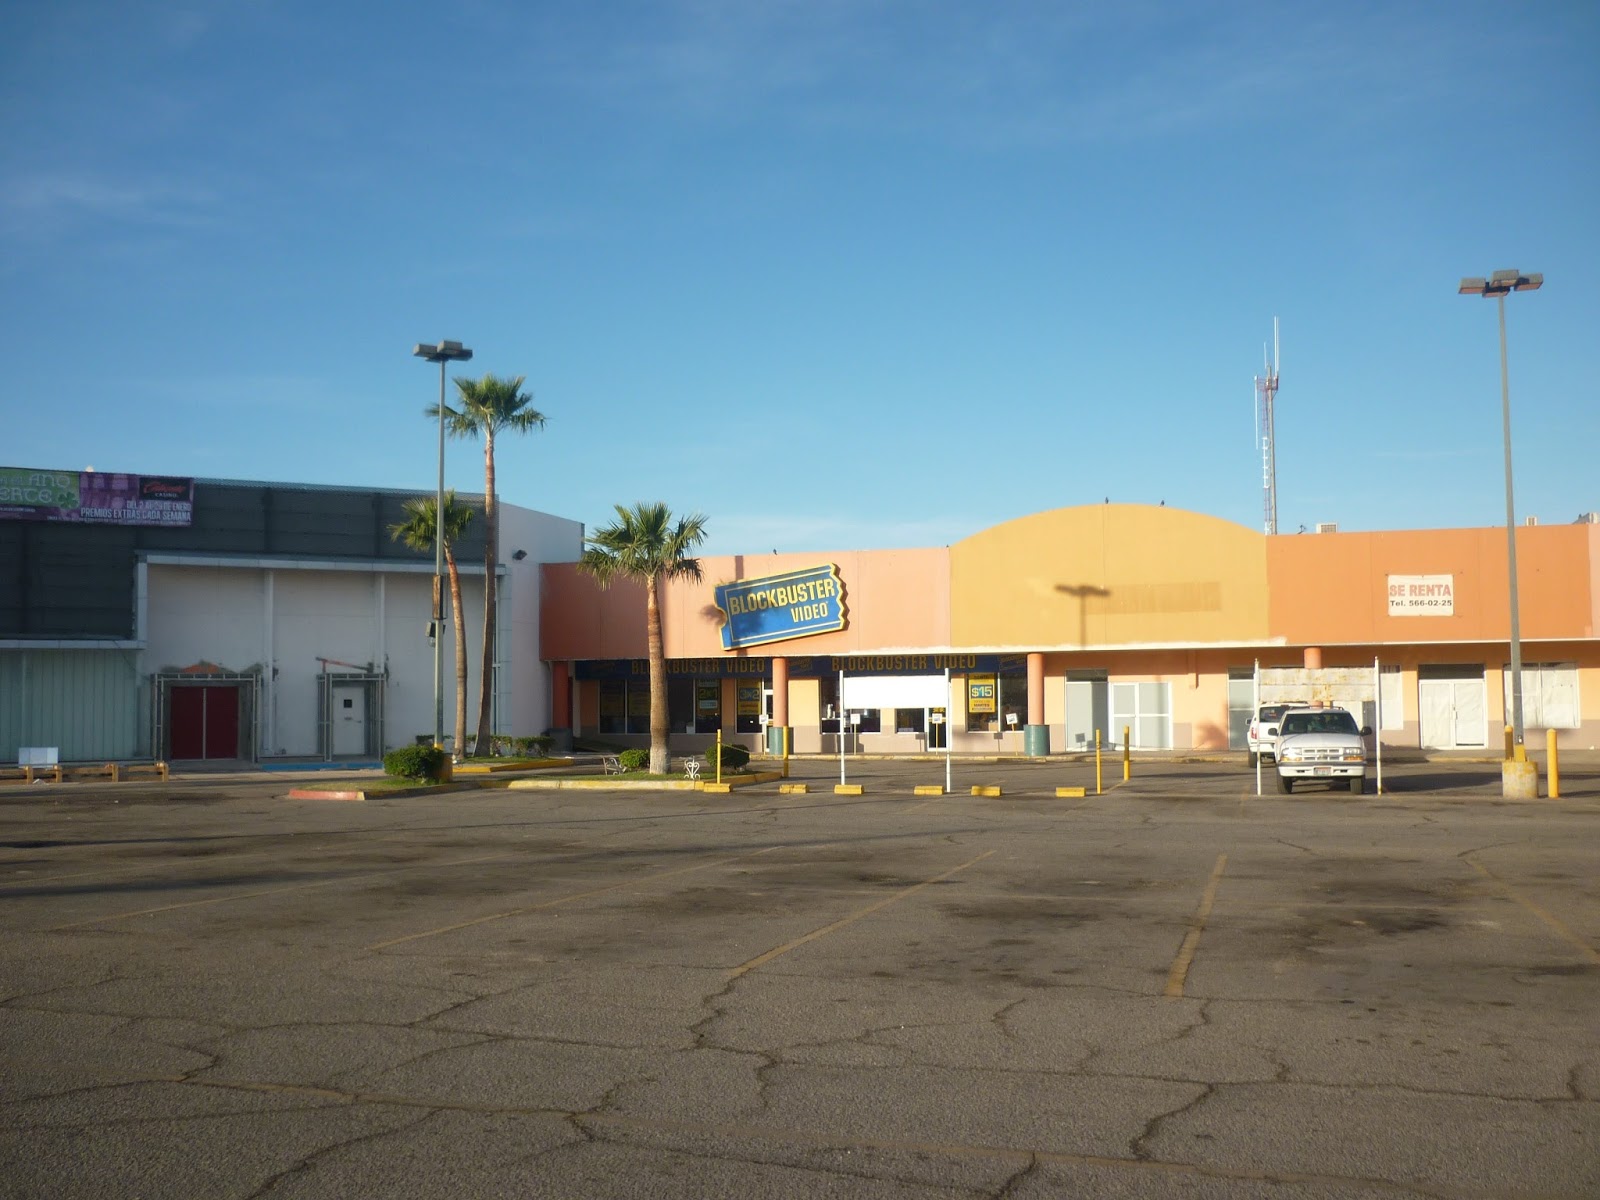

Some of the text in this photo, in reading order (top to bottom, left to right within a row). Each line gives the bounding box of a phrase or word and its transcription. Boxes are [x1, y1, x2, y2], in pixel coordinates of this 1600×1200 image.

[80, 508, 113, 518] PREMIOS
[113, 510, 141, 520] EXTRAS
[142, 511, 161, 520] CADA
[162, 511, 191, 521] SEMANA
[730, 579, 835, 615] BLOCKBUSTER
[1389, 584, 1452, 597] SE RENTA
[1408, 599, 1452, 607] 566-02-25
[791, 602, 828, 623] VIDEO
[632, 659, 720, 674] BLKBUSTER
[726, 658, 765, 673] VIDEO
[831, 655, 928, 672] BLOCKBUSTER
[934, 654, 976, 669] VIDEO
[971, 685, 993, 697] $15
